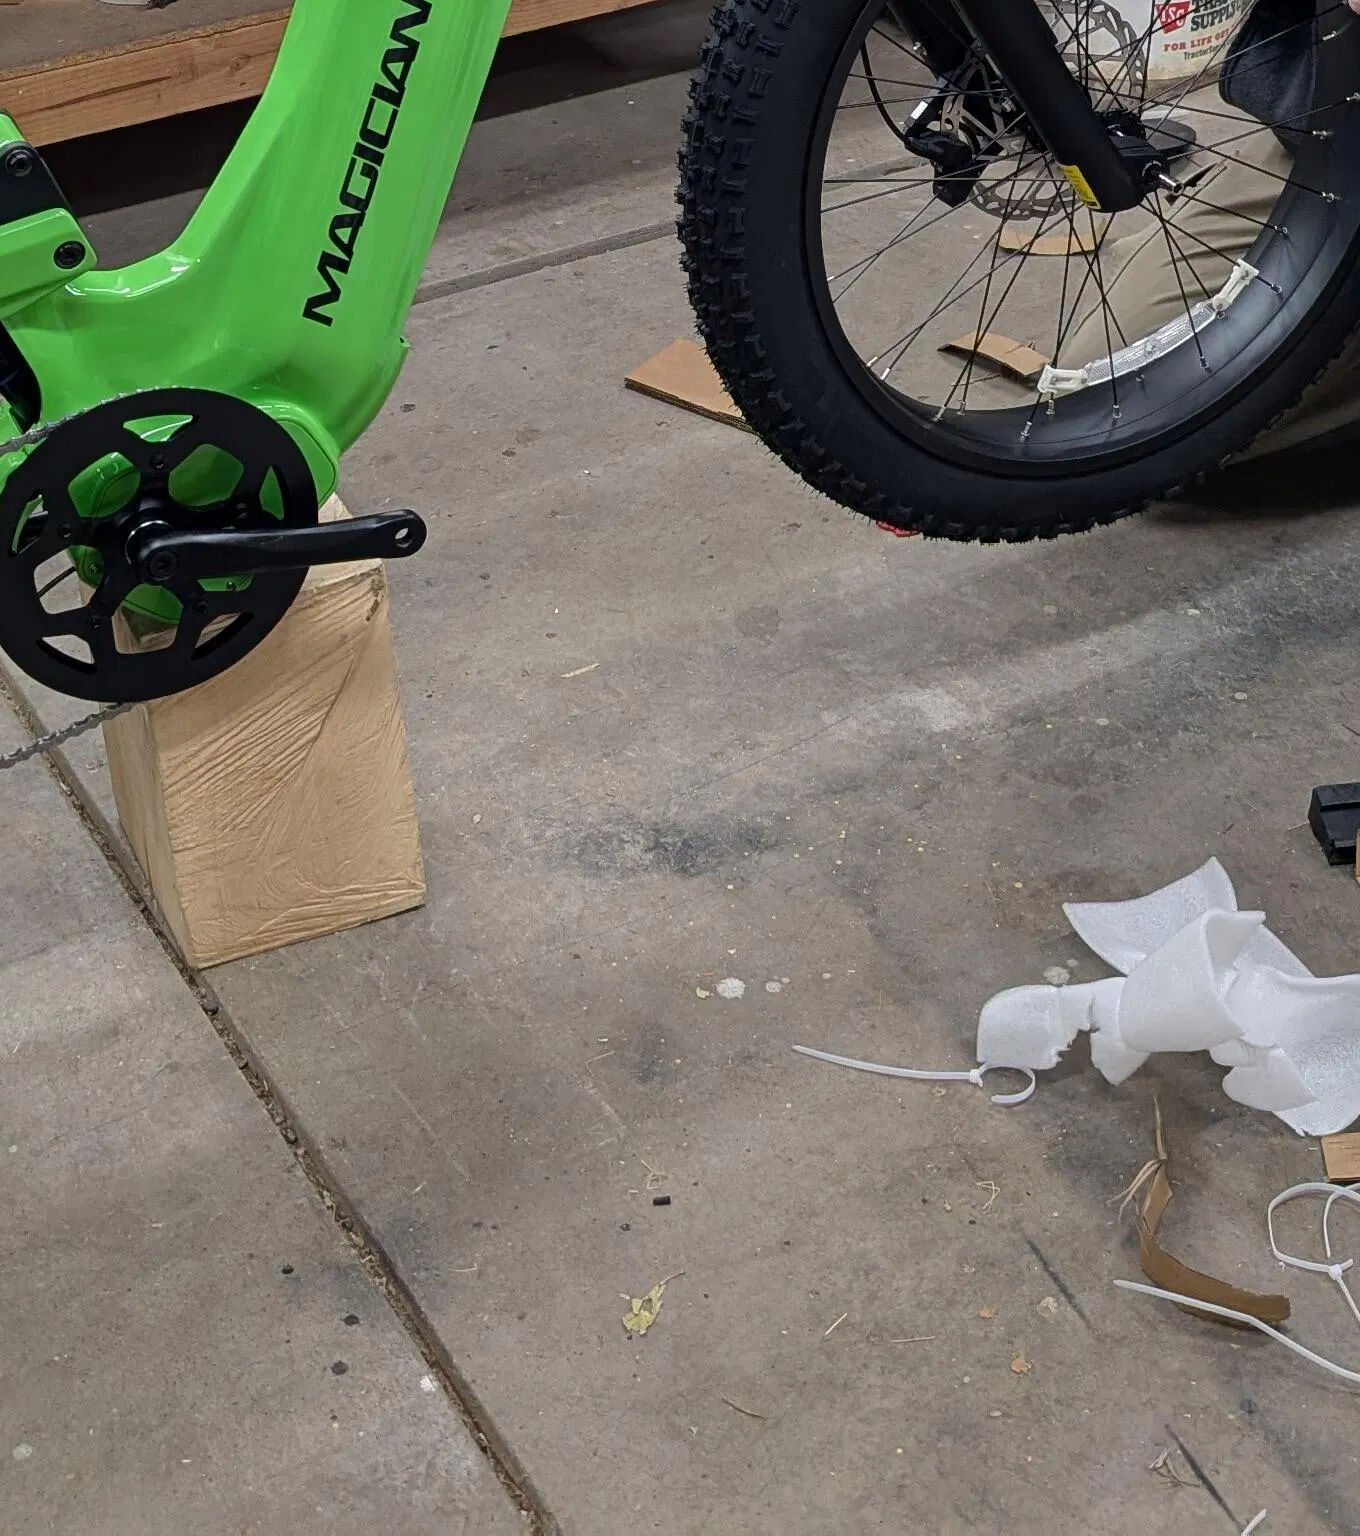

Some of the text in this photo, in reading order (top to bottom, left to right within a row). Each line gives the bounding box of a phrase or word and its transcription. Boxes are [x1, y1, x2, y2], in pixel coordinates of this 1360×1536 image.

[1190, 3, 1237, 32] SUPPLY
[1163, 42, 1186, 52] FOR
[1190, 34, 1213, 48] LIFE
